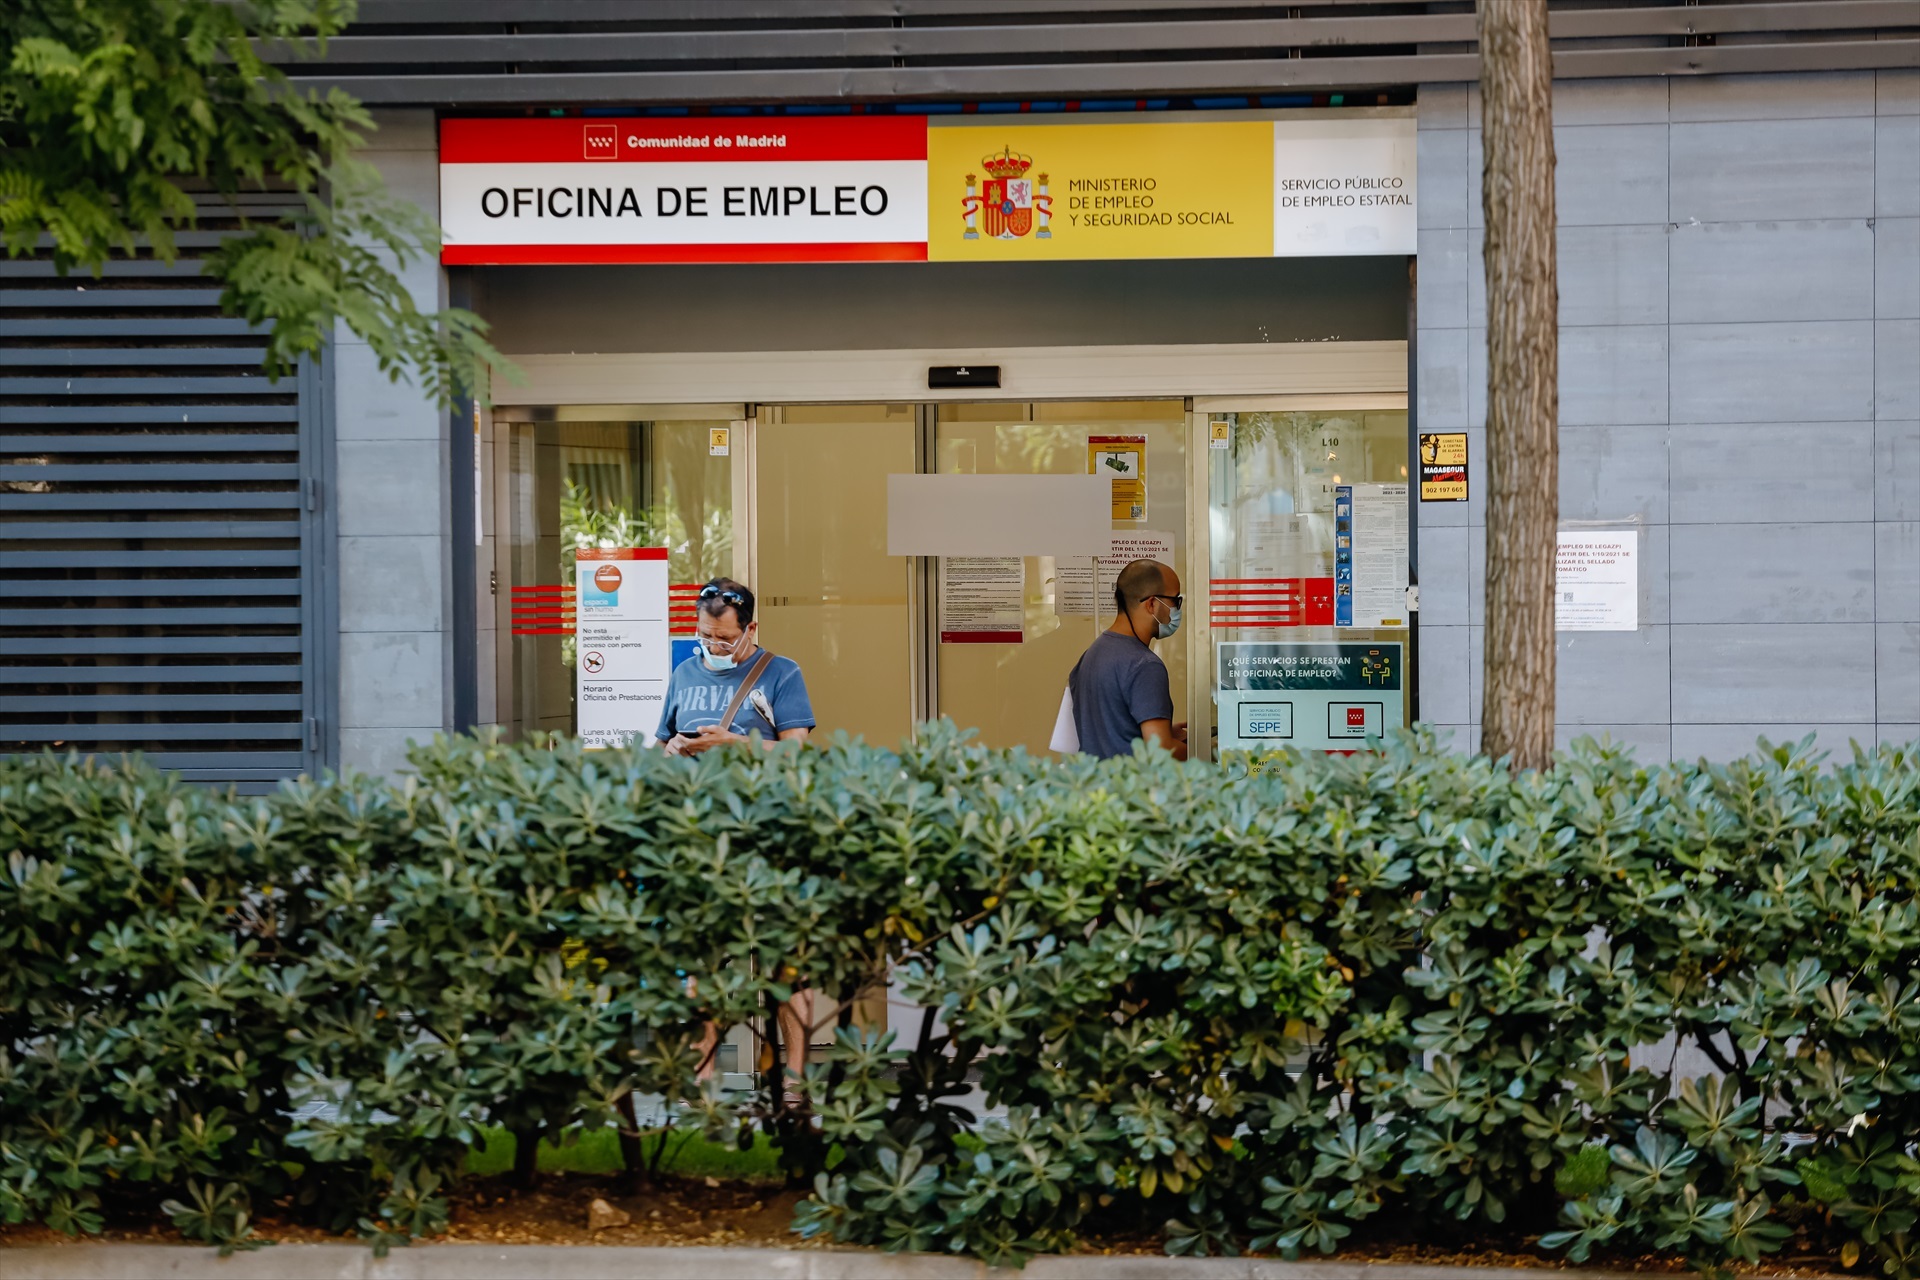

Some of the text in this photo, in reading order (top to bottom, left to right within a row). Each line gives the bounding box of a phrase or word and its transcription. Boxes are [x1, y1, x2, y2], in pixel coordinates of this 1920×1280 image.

[627, 134, 787, 149] Comunidad de Madrid
[1069, 177, 1157, 192] MINISTERIO
[1281, 175, 1403, 191] SERVICIO PÚBLICO
[481, 185, 889, 218] OFICINA DE EMPLEO
[1069, 195, 1154, 209] DE EMPLEO
[1281, 193, 1413, 208] DE EMPLEO ESTATAL
[1069, 212, 1234, 227] Y SEGURIDAD SOCIAL
[1322, 438, 1339, 446] L10
[1227, 655, 1351, 666] ¿QUÉ SERVICIOS SE PRESTAN
[1242, 669, 1284, 678] OFICINAS
[1285, 669, 1296, 678] DE
[1298, 669, 1337, 678] EMPLEO?
[583, 685, 613, 693] Horario
[583, 693, 662, 701] Oficina de Prestaciones
[677, 685, 765, 712] NIRVA
[1249, 722, 1281, 733] SEPE
